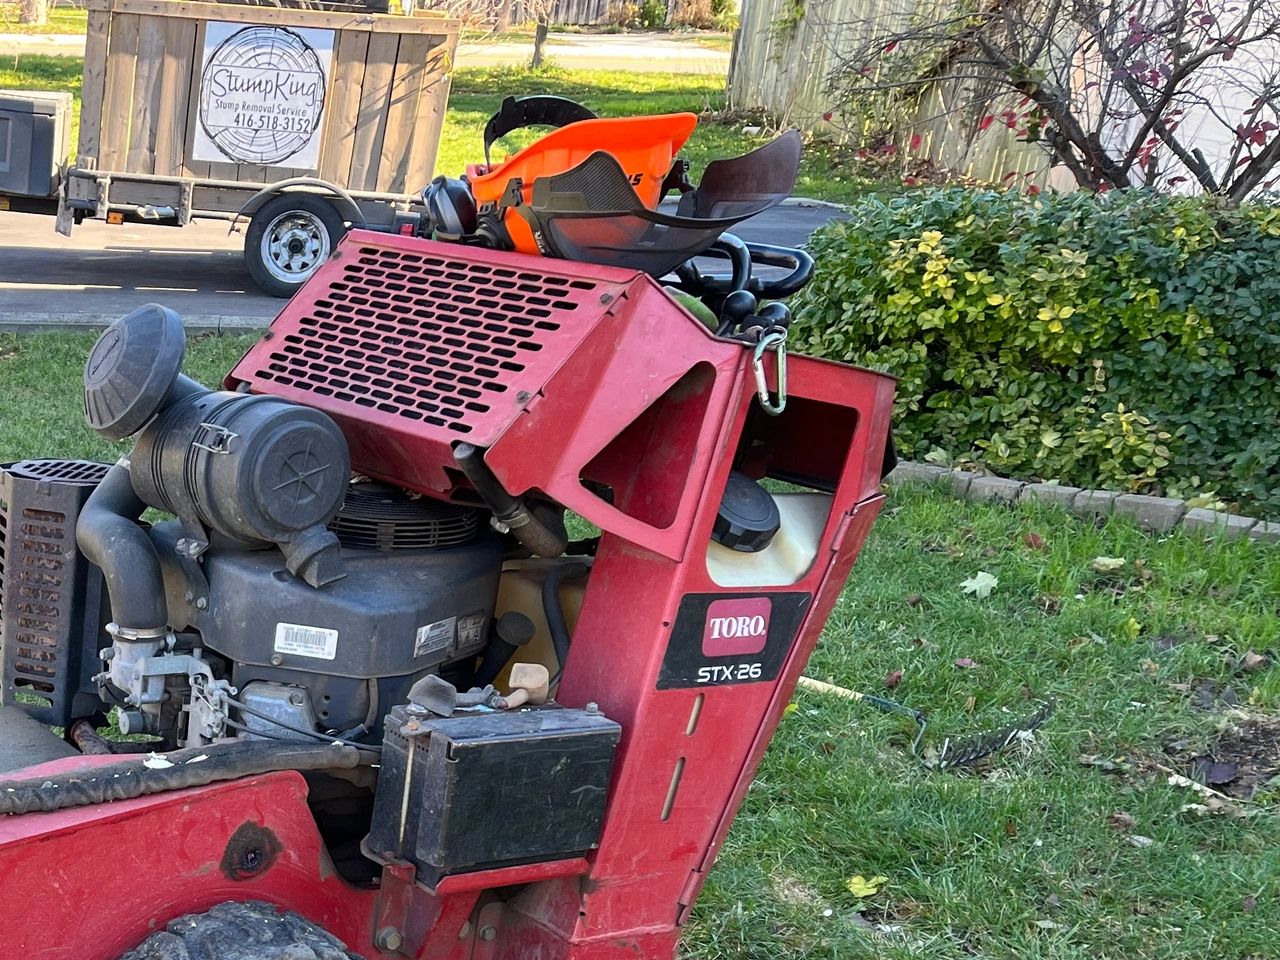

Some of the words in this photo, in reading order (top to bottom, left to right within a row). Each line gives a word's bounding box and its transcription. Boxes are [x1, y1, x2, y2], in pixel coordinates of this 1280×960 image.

[215, 98, 239, 112] Stump
[242, 102, 275, 114] Removal
[277, 104, 307, 117] Service
[234, 112, 310, 133] 416-518-3152
[709, 615, 765, 639] TORO
